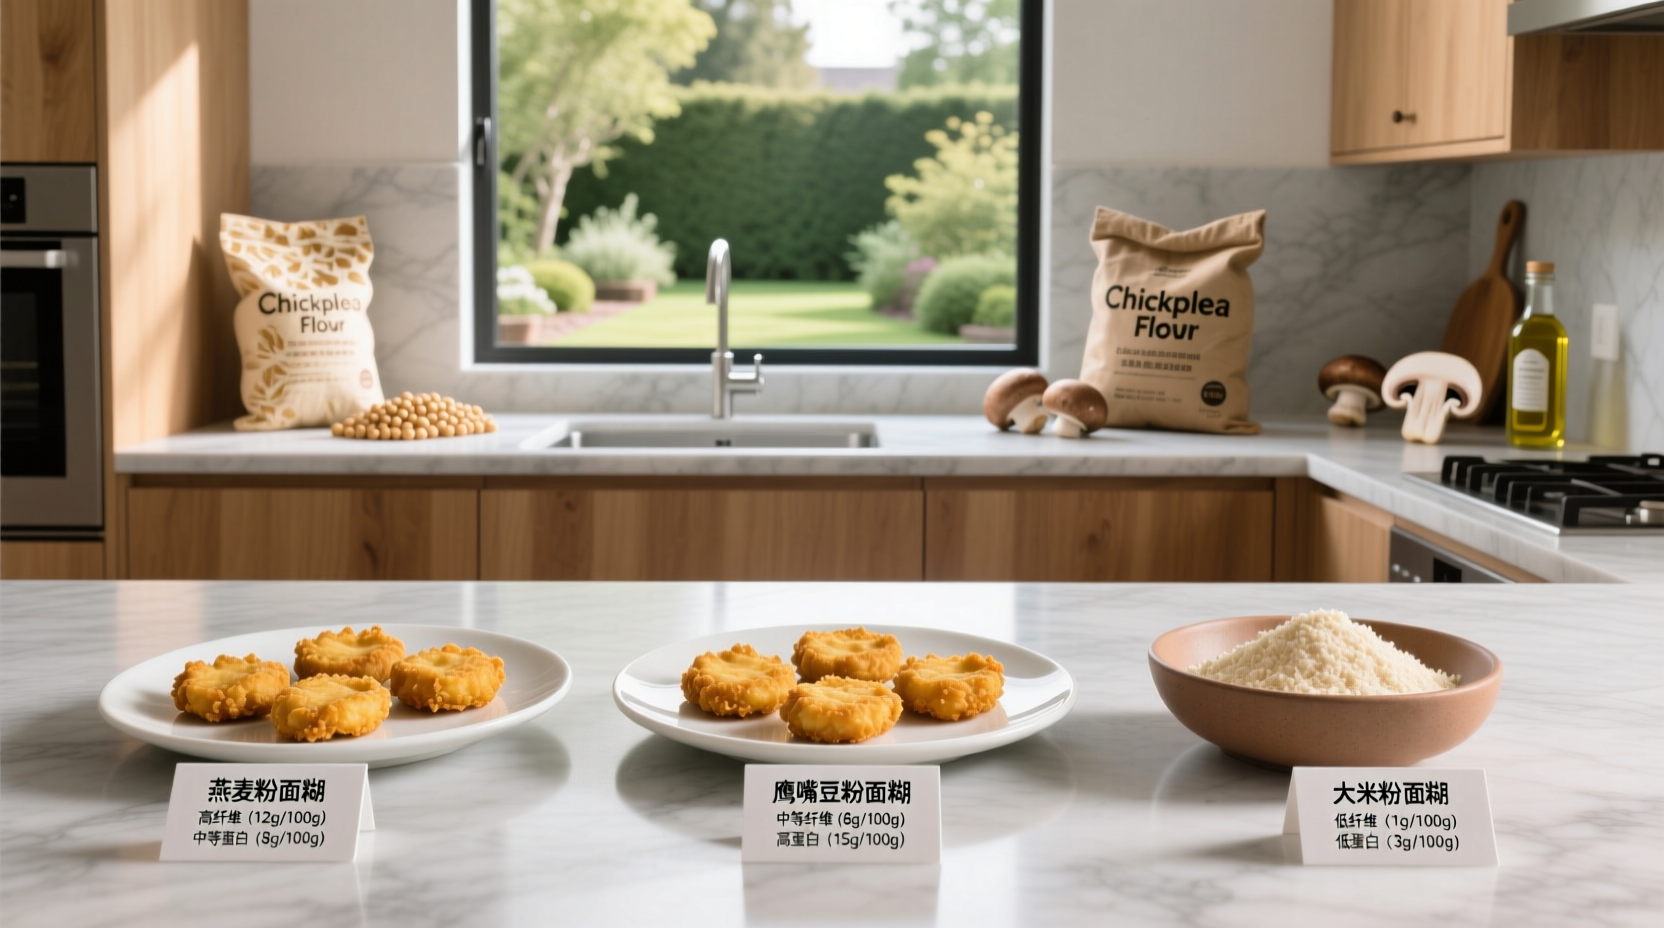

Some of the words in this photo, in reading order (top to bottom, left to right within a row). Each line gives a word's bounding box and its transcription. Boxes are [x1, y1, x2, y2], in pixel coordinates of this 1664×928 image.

[258, 291, 361, 316] Chickplea
[1105, 284, 1230, 319] Chickplea
[207, 776, 326, 803] 燕麦粉面糊
[772, 779, 911, 804] 鹰嘴豆粉面糊
[1333, 780, 1449, 806] 大米粉面糊
